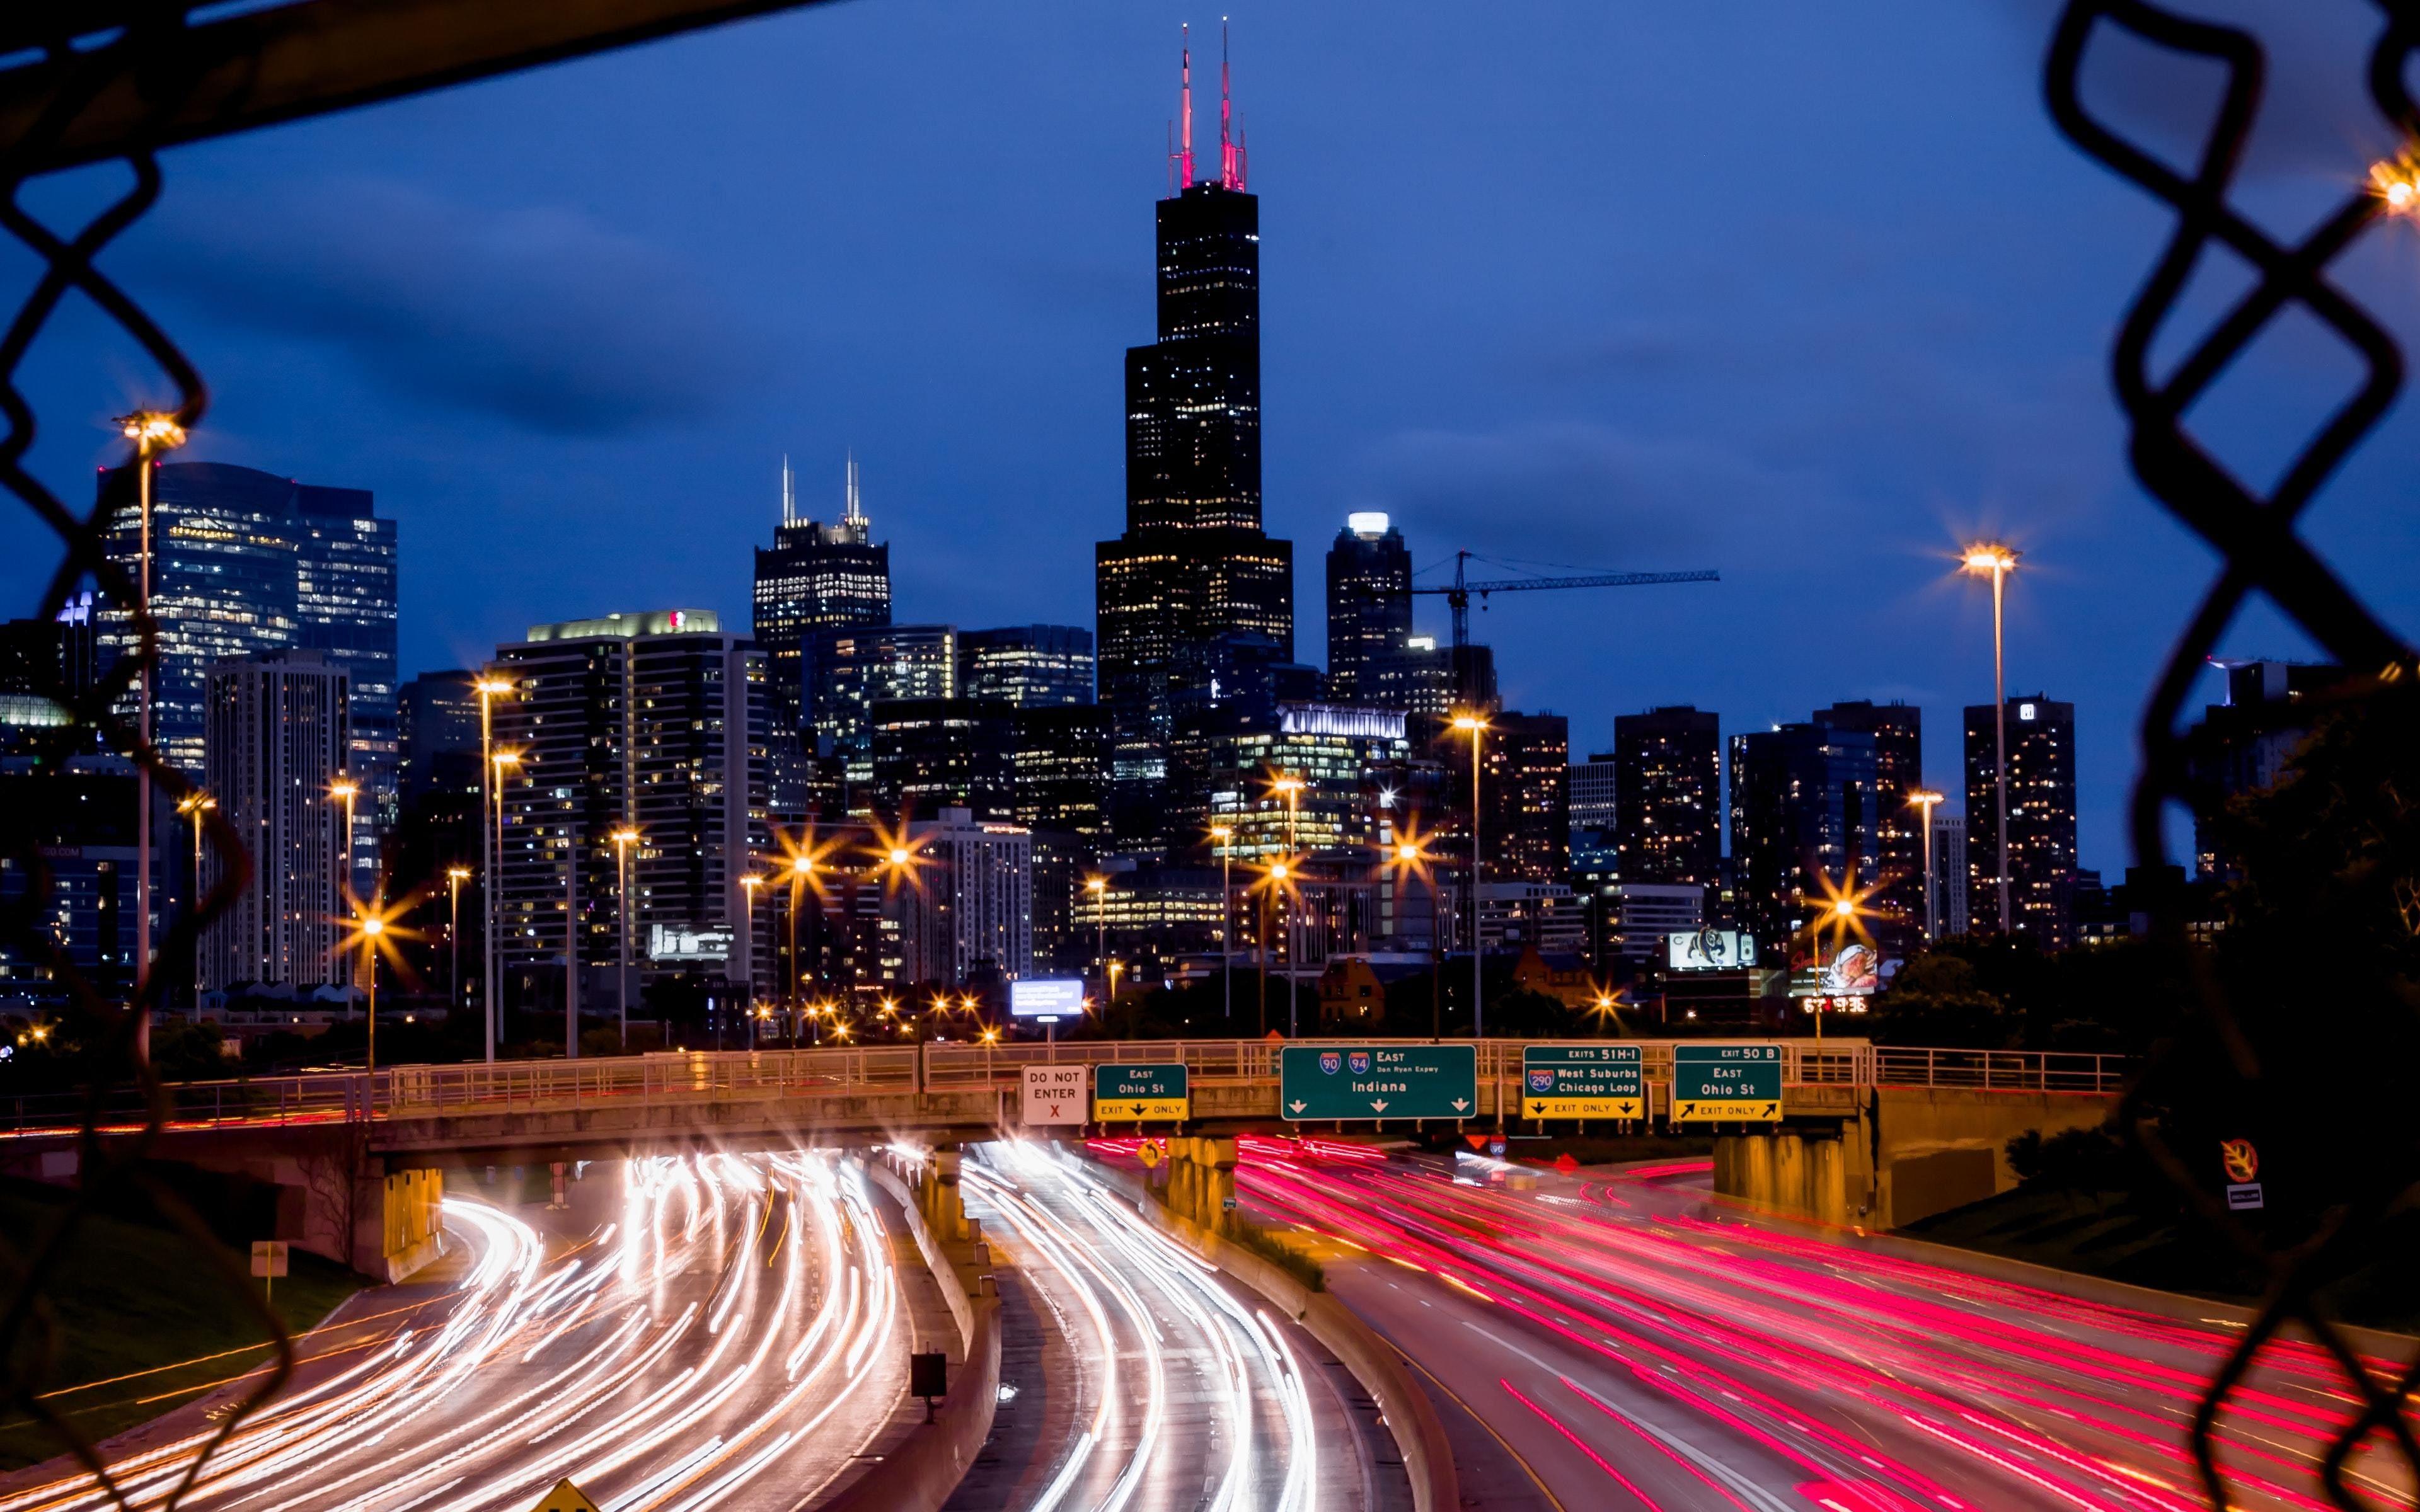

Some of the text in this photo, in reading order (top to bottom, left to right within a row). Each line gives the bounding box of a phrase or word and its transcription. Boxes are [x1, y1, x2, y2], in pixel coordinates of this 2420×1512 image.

[1376, 1051, 1404, 1062] EAST
[1569, 1050, 1594, 1058] EXITS
[1743, 1048, 1760, 1059] 50
[1766, 1048, 1775, 1059] B
[1323, 1059, 1337, 1070] 90
[1352, 1059, 1366, 1069] 94
[1129, 1070, 1153, 1079] EAST
[1393, 1065, 1412, 1074] Ryan
[1558, 1068, 1637, 1078] West Suburbs
[1714, 1068, 1742, 1078] EAST
[1030, 1073, 1080, 1082] DO NOT
[1532, 1076, 1552, 1086] 290
[1119, 1084, 1165, 1094] Ohio St
[1352, 1081, 1406, 1092] Indiana
[1559, 1083, 1637, 1094] Chicago Loop
[1702, 1084, 1754, 1095] Ohio St
[1034, 1089, 1075, 1099] ENTER
[1051, 1104, 1059, 1117] X
